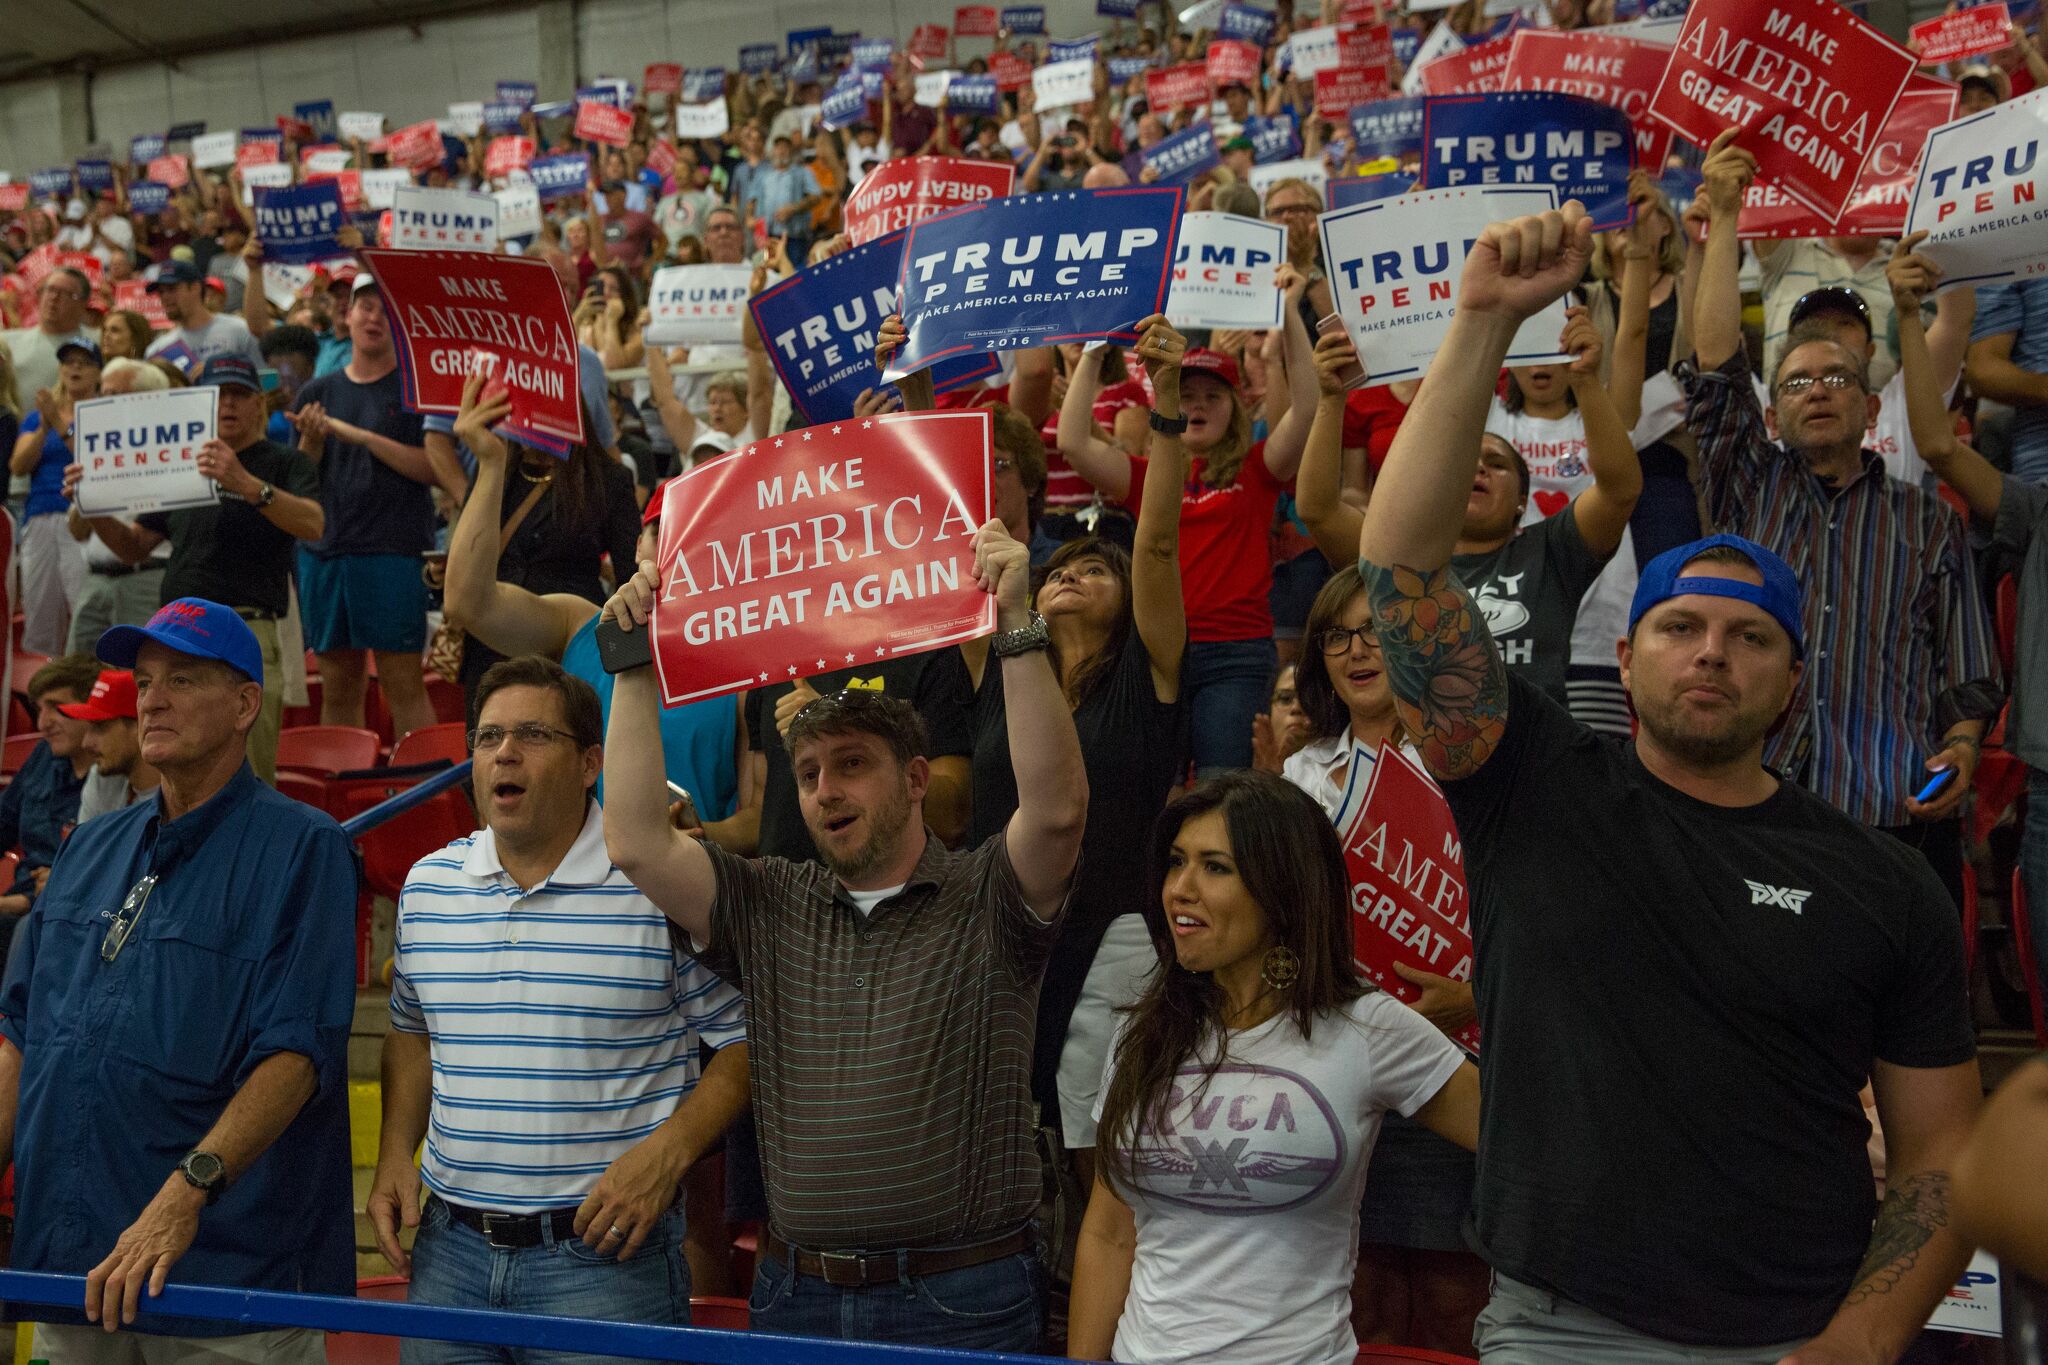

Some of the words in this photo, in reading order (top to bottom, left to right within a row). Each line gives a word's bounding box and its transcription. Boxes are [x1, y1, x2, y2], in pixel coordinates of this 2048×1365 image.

[1763, 8, 1839, 66] MAKE
[1470, 53, 1508, 74] MAK
[1564, 53, 1626, 78] MAKE
[1508, 74, 1650, 120] AMERIC
[1681, 17, 1869, 155] AMERICA
[1679, 69, 1763, 127] GREAT
[1760, 113, 1845, 181] AGAIN
[1434, 130, 1623, 164] TRUMP
[1448, 161, 1604, 186] PENCE
[1931, 140, 2039, 198] TRU
[855, 180, 914, 215] AGAIN
[917, 179, 993, 201] GREAT
[1569, 184, 1610, 196] AGAIN!
[1743, 184, 1798, 208] REA
[1850, 183, 1912, 206] AIN
[1938, 181, 2036, 223] PEN
[256, 200, 338, 224] TRUMP
[399, 209, 493, 230] TRUMP
[850, 203, 943, 248] ERICA
[1930, 225, 1966, 243] MAKE
[1970, 213, 2029, 237] AMERICA
[403, 227, 483, 244] PENCE
[915, 227, 1159, 283] TRUMP
[1175, 244, 1271, 268] UMP
[1340, 238, 1477, 290] TRU
[2026, 262, 2047, 274] 20
[438, 275, 509, 302] MAKE
[924, 263, 1126, 303] PENCE
[1172, 268, 1252, 285] NCE
[658, 288, 746, 302] TRUMP
[917, 305, 950, 321] MAKE
[954, 297, 1018, 312] AMERICA
[1023, 291, 1072, 303] GREAT
[1076, 286, 1130, 300] AGAIN!
[1360, 280, 1451, 316] PEN
[407, 303, 574, 365] AMERICA
[775, 286, 897, 361] TRUM
[1360, 320, 1387, 334] MAKE
[1389, 310, 1443, 328] AMERICA
[800, 331, 874, 380] PEN
[986, 336, 1031, 349] 2016
[430, 349, 500, 380] GREAT
[503, 360, 564, 401] AGAIN
[829, 359, 872, 385] AMERICA
[85, 421, 206, 452] TRUMP
[94, 447, 192, 470] PENCE
[757, 457, 865, 511] MAKE
[660, 489, 979, 602] AMERICA
[683, 588, 812, 646] GREAT
[824, 556, 960, 618] AGAIN
[1351, 881, 1451, 966] GREAT
